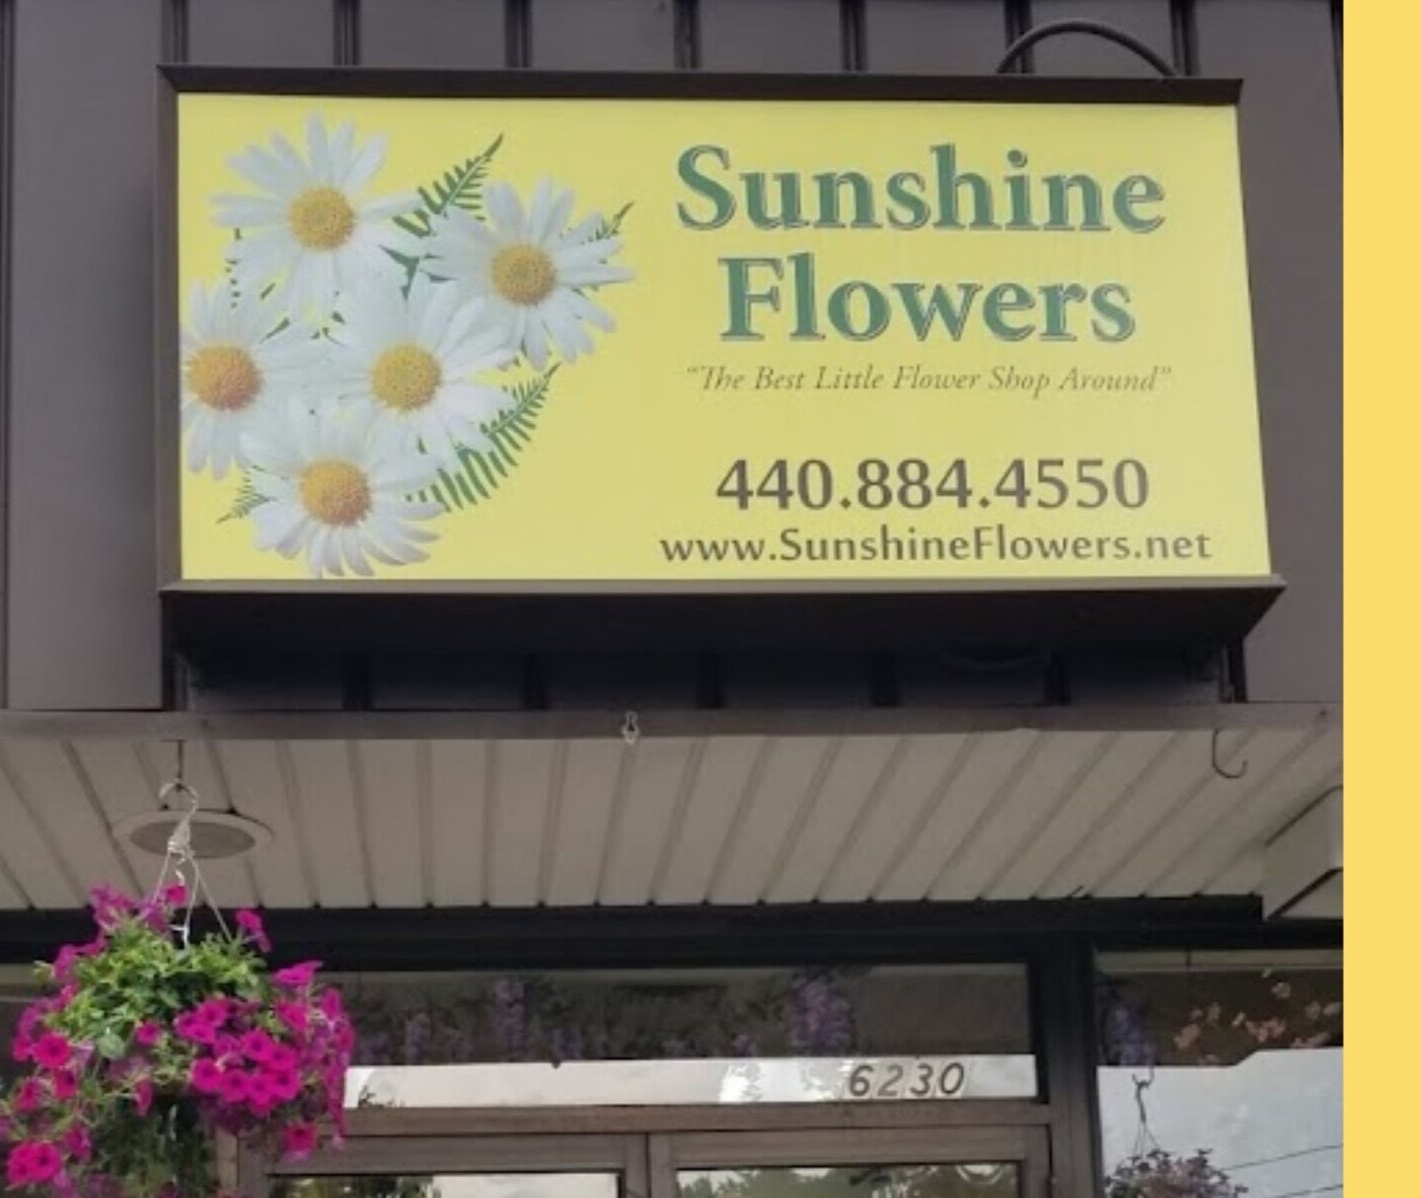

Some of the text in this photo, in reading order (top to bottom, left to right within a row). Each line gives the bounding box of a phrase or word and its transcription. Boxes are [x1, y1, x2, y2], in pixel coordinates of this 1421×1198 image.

[676, 142, 1166, 234] Sunshine
[717, 252, 1136, 342] Flowers
[754, 364, 806, 390] Best
[814, 363, 884, 390] Little
[892, 363, 981, 390] Flower
[987, 364, 1051, 399] Shop
[716, 457, 1149, 511] 440.884.4550
[659, 524, 1213, 562] www.SunshineFlowers.net
[849, 1062, 965, 1097] 6230
